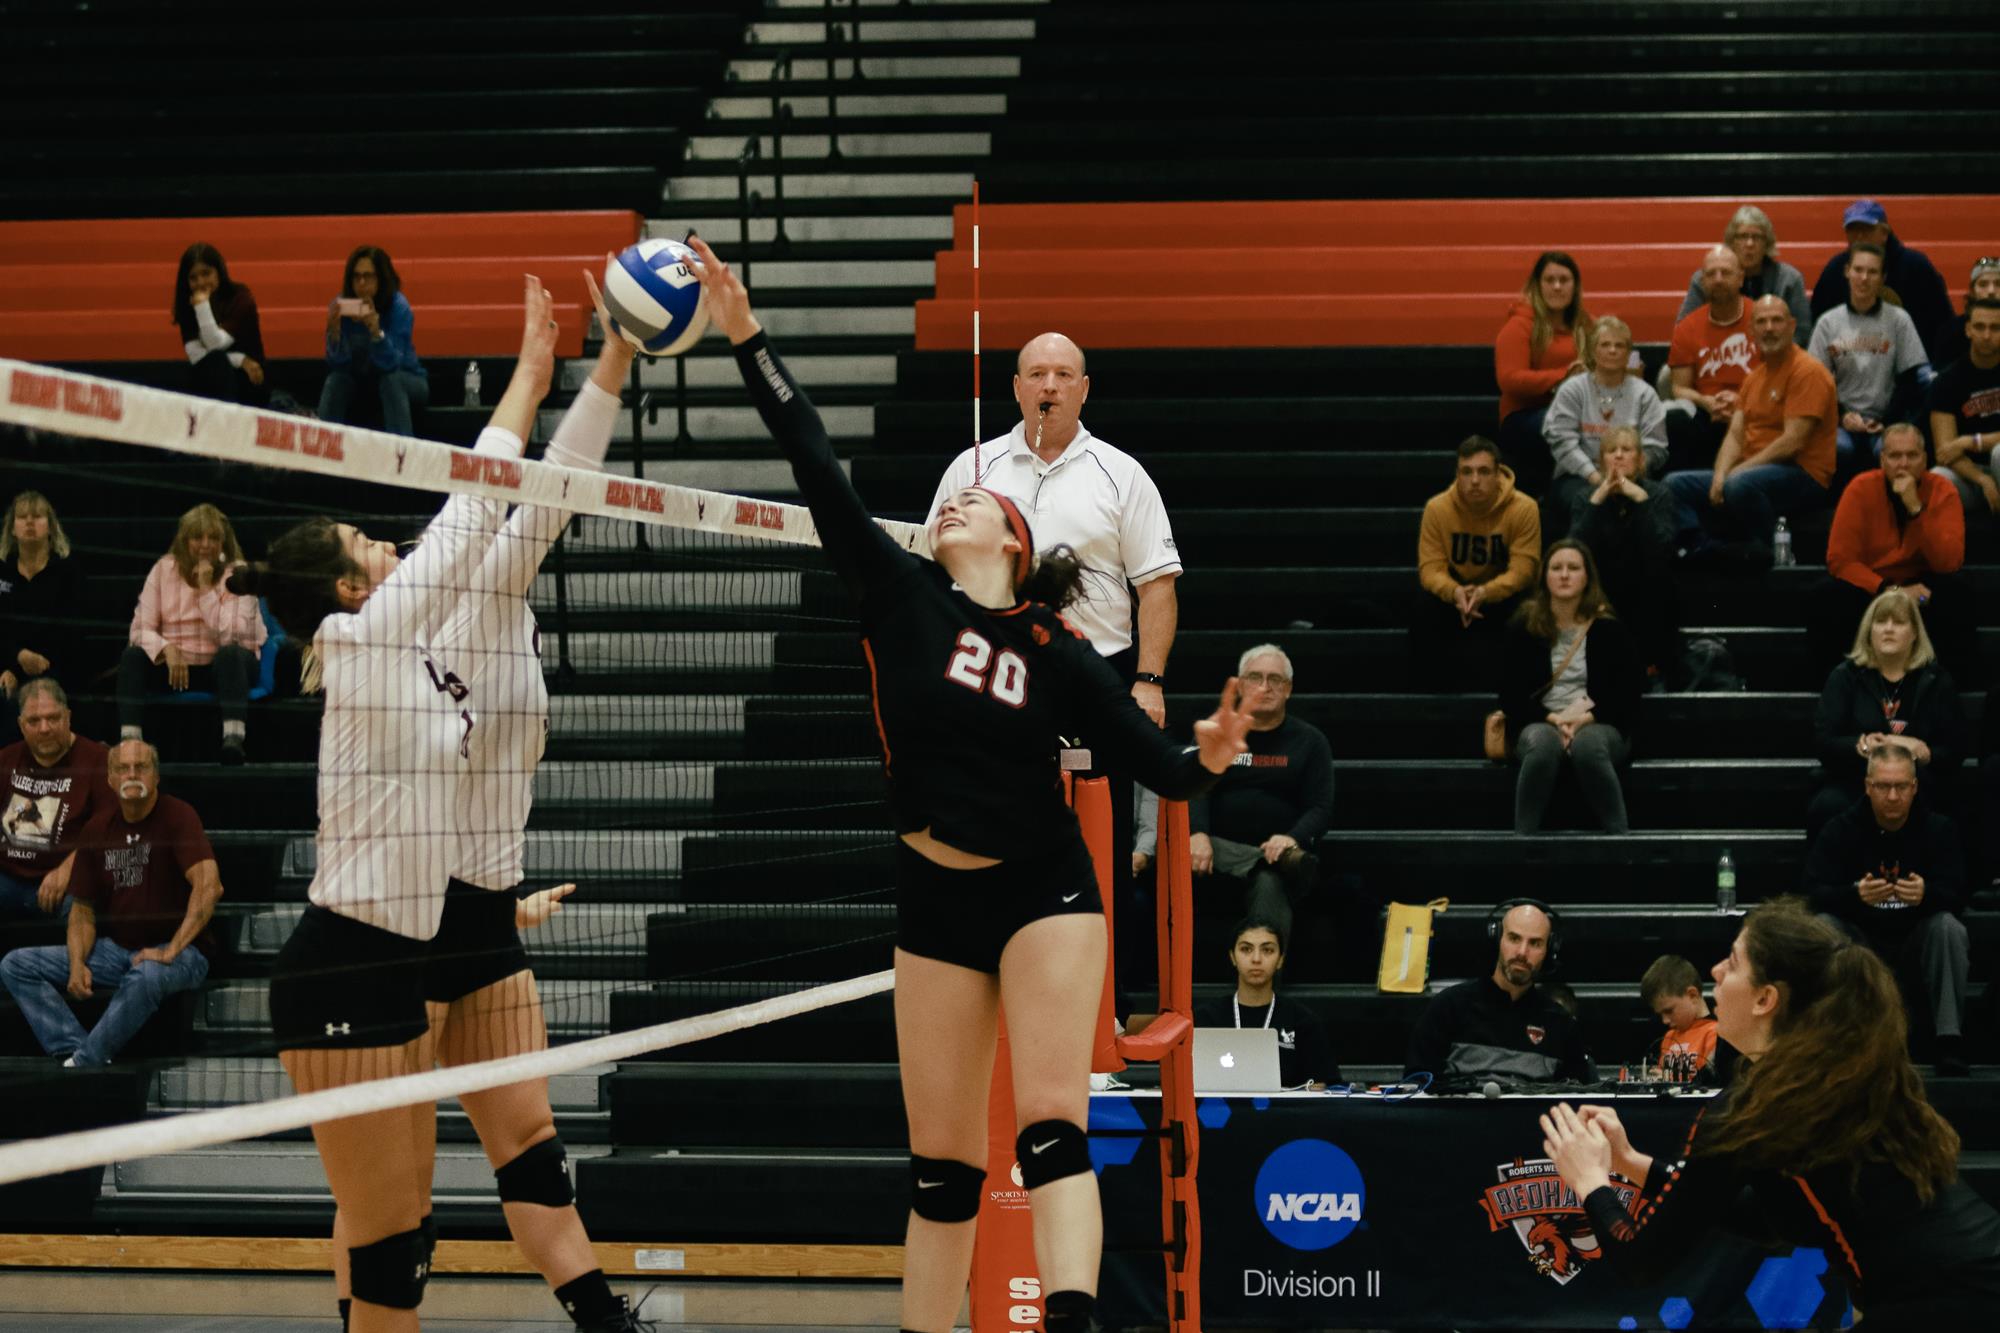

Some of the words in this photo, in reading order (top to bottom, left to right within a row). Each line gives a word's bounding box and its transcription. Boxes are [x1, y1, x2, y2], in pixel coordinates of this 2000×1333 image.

[1451, 532, 1509, 567] USA
[944, 627, 1029, 709] 20
[1509, 1165, 1543, 1177] ROBERTS
[990, 1191, 1021, 1201] SPORTS
[1266, 1193, 1362, 1222] NCAA
[1493, 1179, 1636, 1217] REDHAS
[1243, 1269, 1356, 1297] Division
[1367, 1269, 1380, 1297] II
[1009, 1277, 1041, 1333] se
